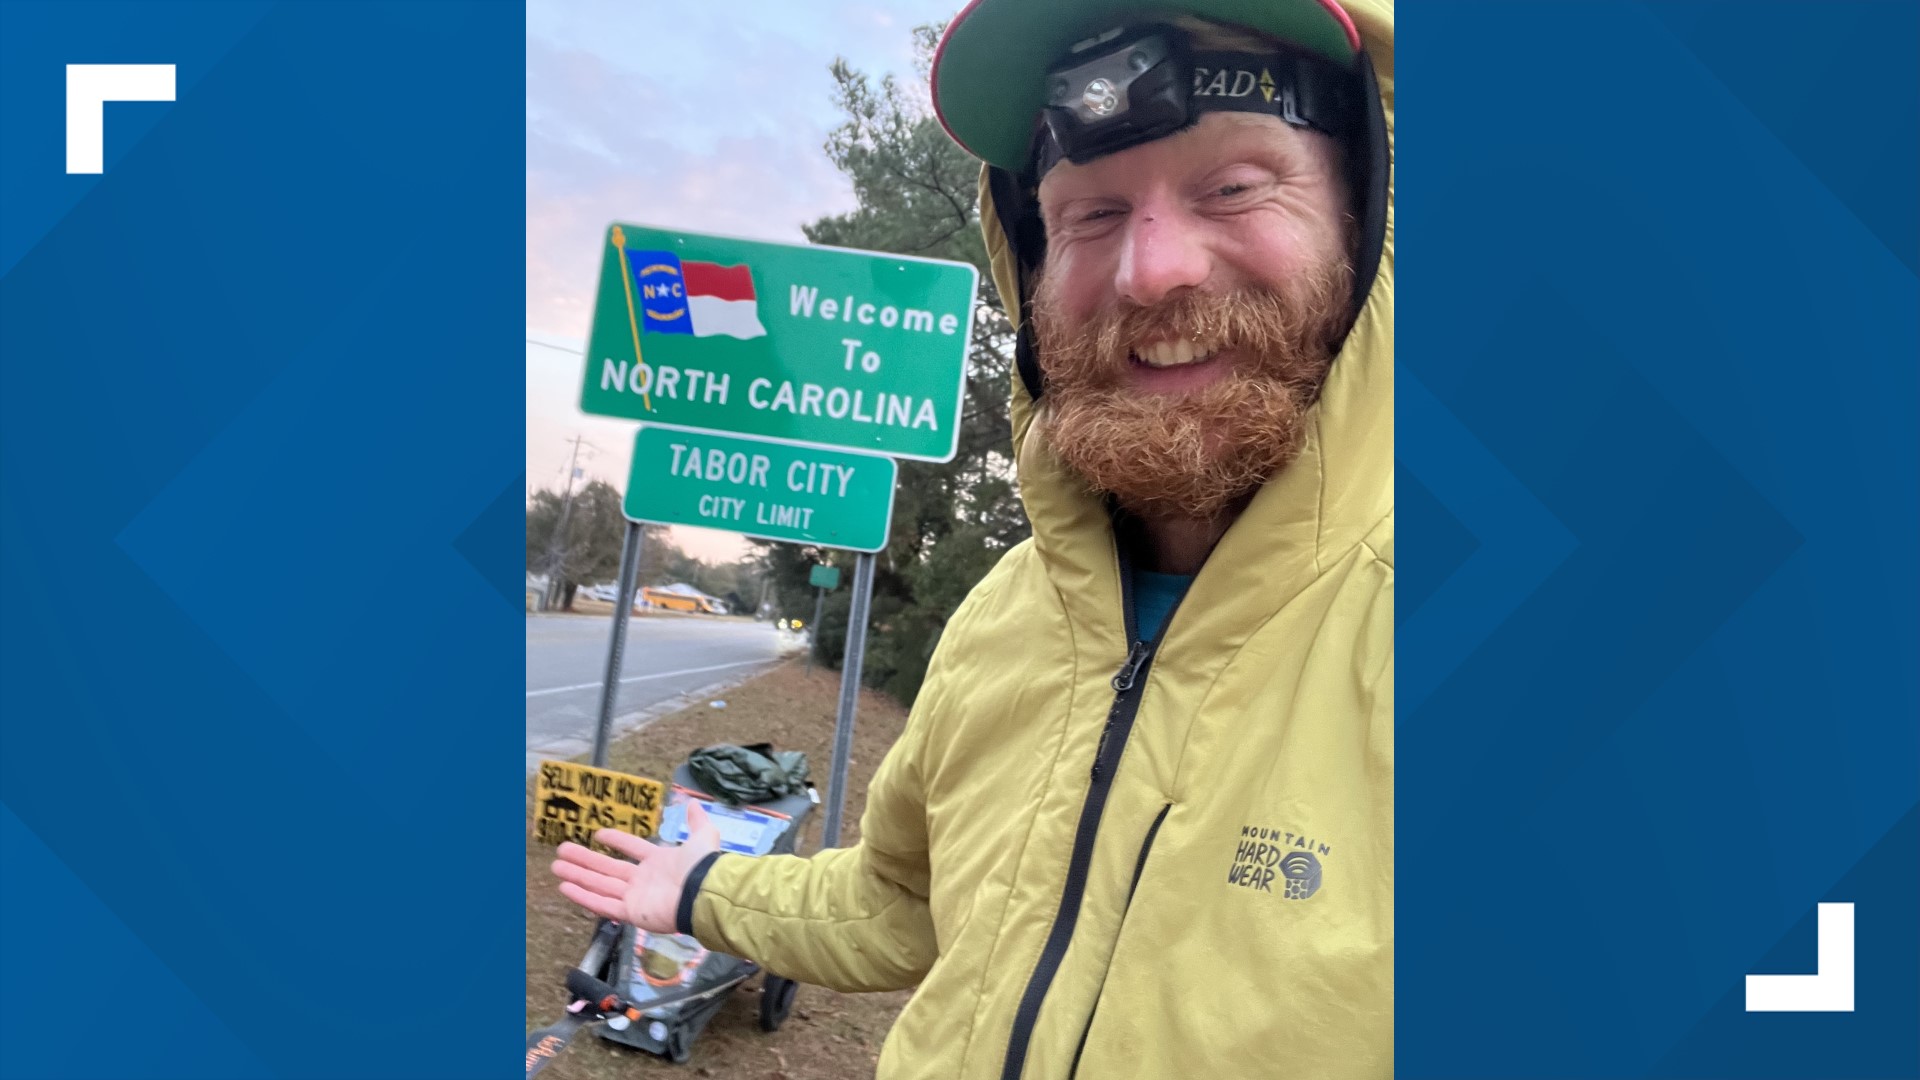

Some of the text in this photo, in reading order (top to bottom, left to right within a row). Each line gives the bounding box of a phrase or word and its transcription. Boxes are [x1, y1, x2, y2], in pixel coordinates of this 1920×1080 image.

[643, 282, 682, 300] N C
[789, 284, 959, 335] Welcome
[841, 338, 881, 374] To
[600, 357, 938, 432] NORTH CAROLINA
[669, 442, 855, 498] TABOR CITY
[698, 494, 814, 530] CITY LIMIT
[541, 763, 658, 812] SELL YOUR HOUSE
[585, 802, 653, 839] AS-IS
[1235, 839, 1281, 868] HARD
[1241, 825, 1331, 857] MOUNTAIN
[1227, 862, 1276, 894] WEAR
